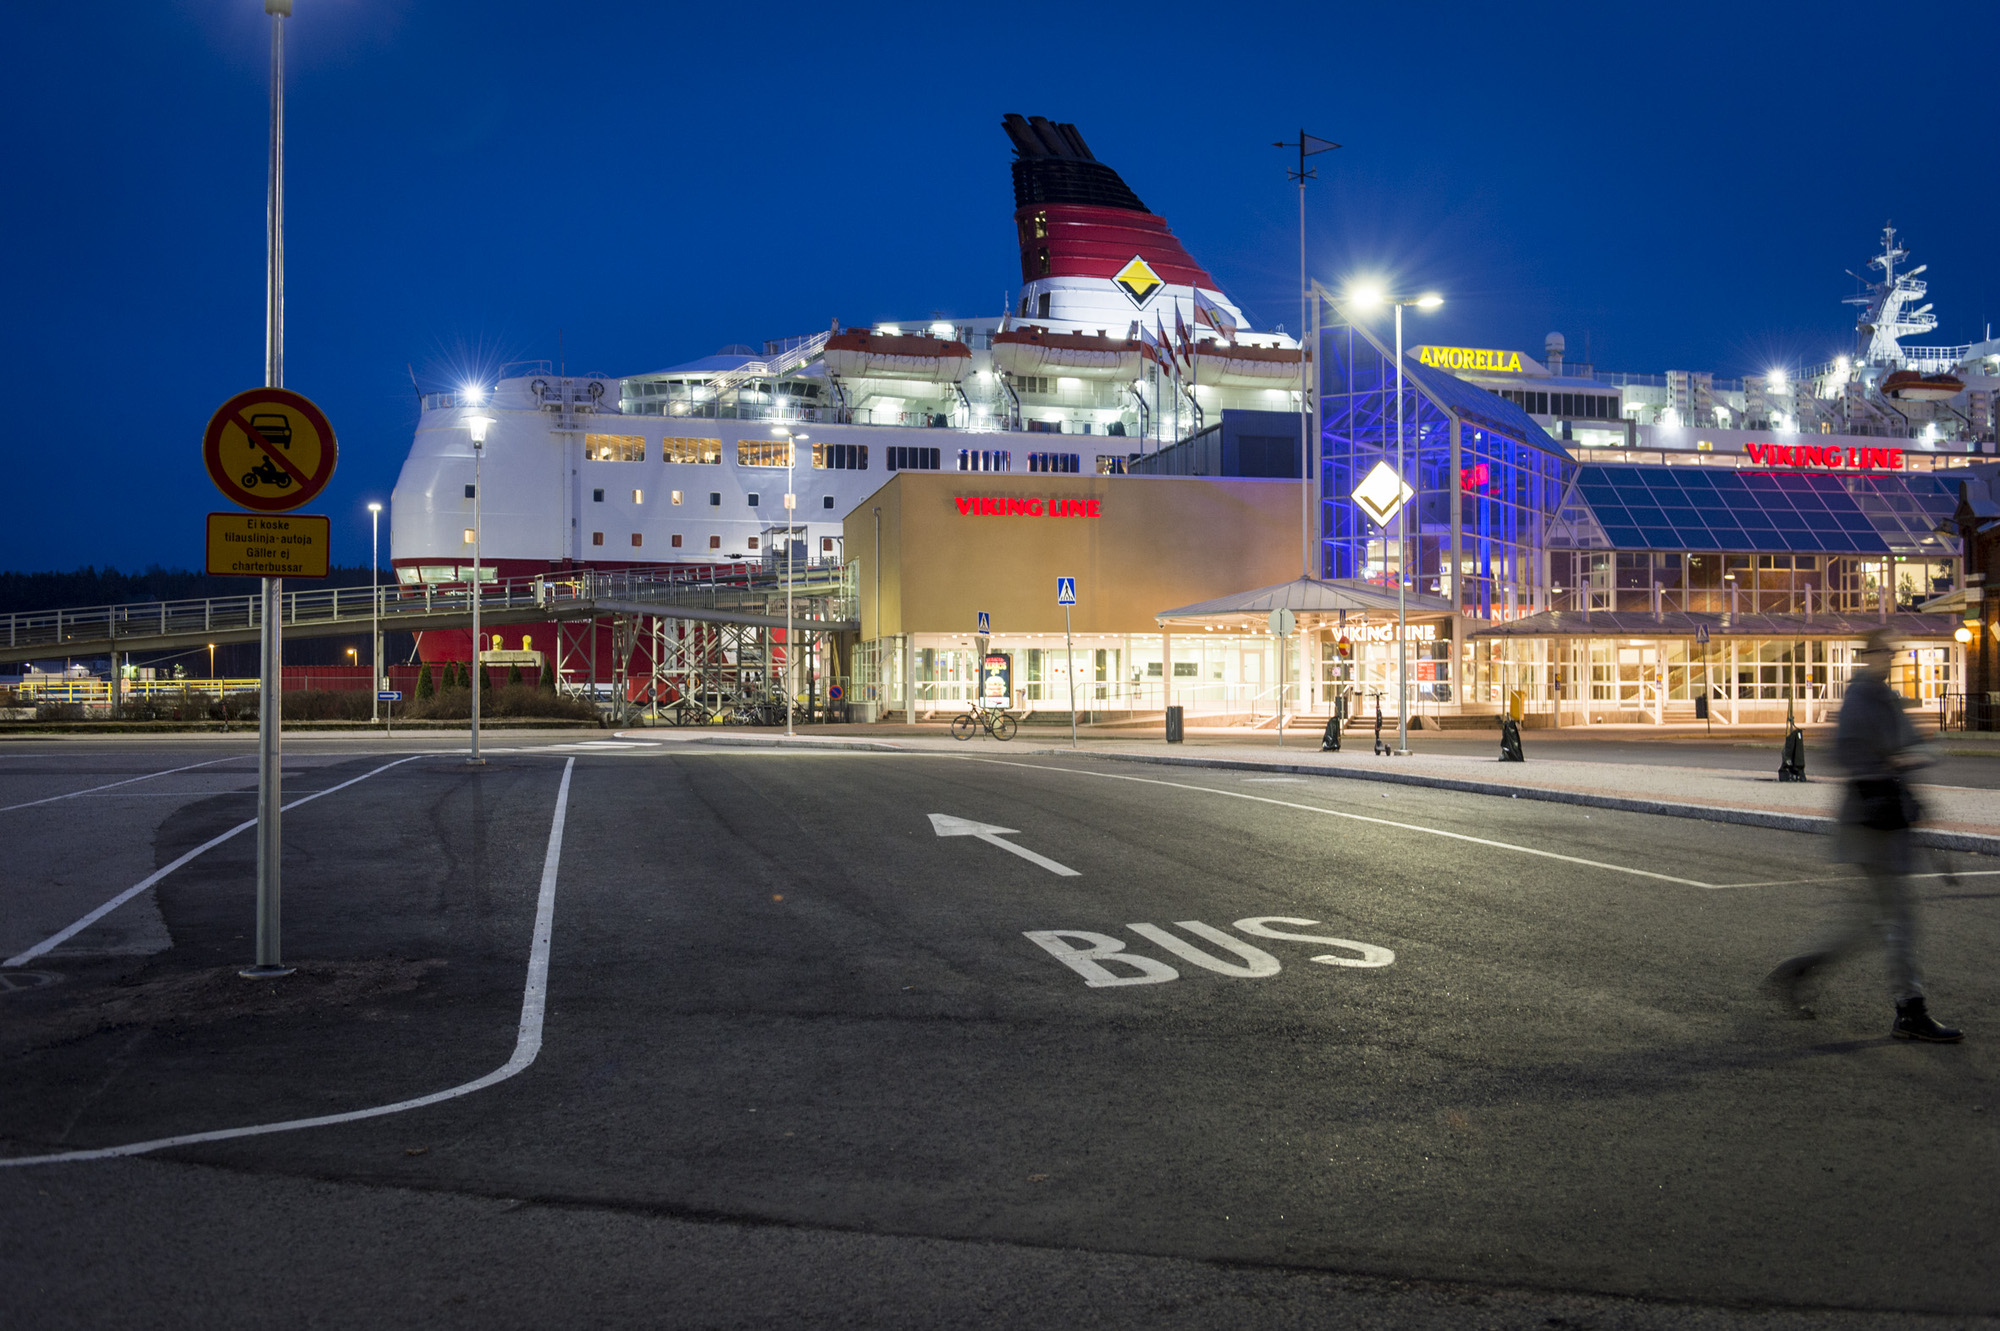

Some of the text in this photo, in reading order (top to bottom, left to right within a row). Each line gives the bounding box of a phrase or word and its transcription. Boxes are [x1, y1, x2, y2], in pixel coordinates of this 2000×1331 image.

[1420, 346, 1522, 372] AMORELLA
[1747, 442, 1903, 469] VIKING LINE
[954, 496, 1101, 518] VIKING LINE
[247, 519, 290, 530] Ei koske
[225, 532, 312, 546] tilauslinja-autoja
[246, 547, 290, 560] Gäller ej
[232, 561, 303, 573] charterbussar
[1331, 625, 1393, 641] VIKING
[1021, 916, 1396, 988] BUS
